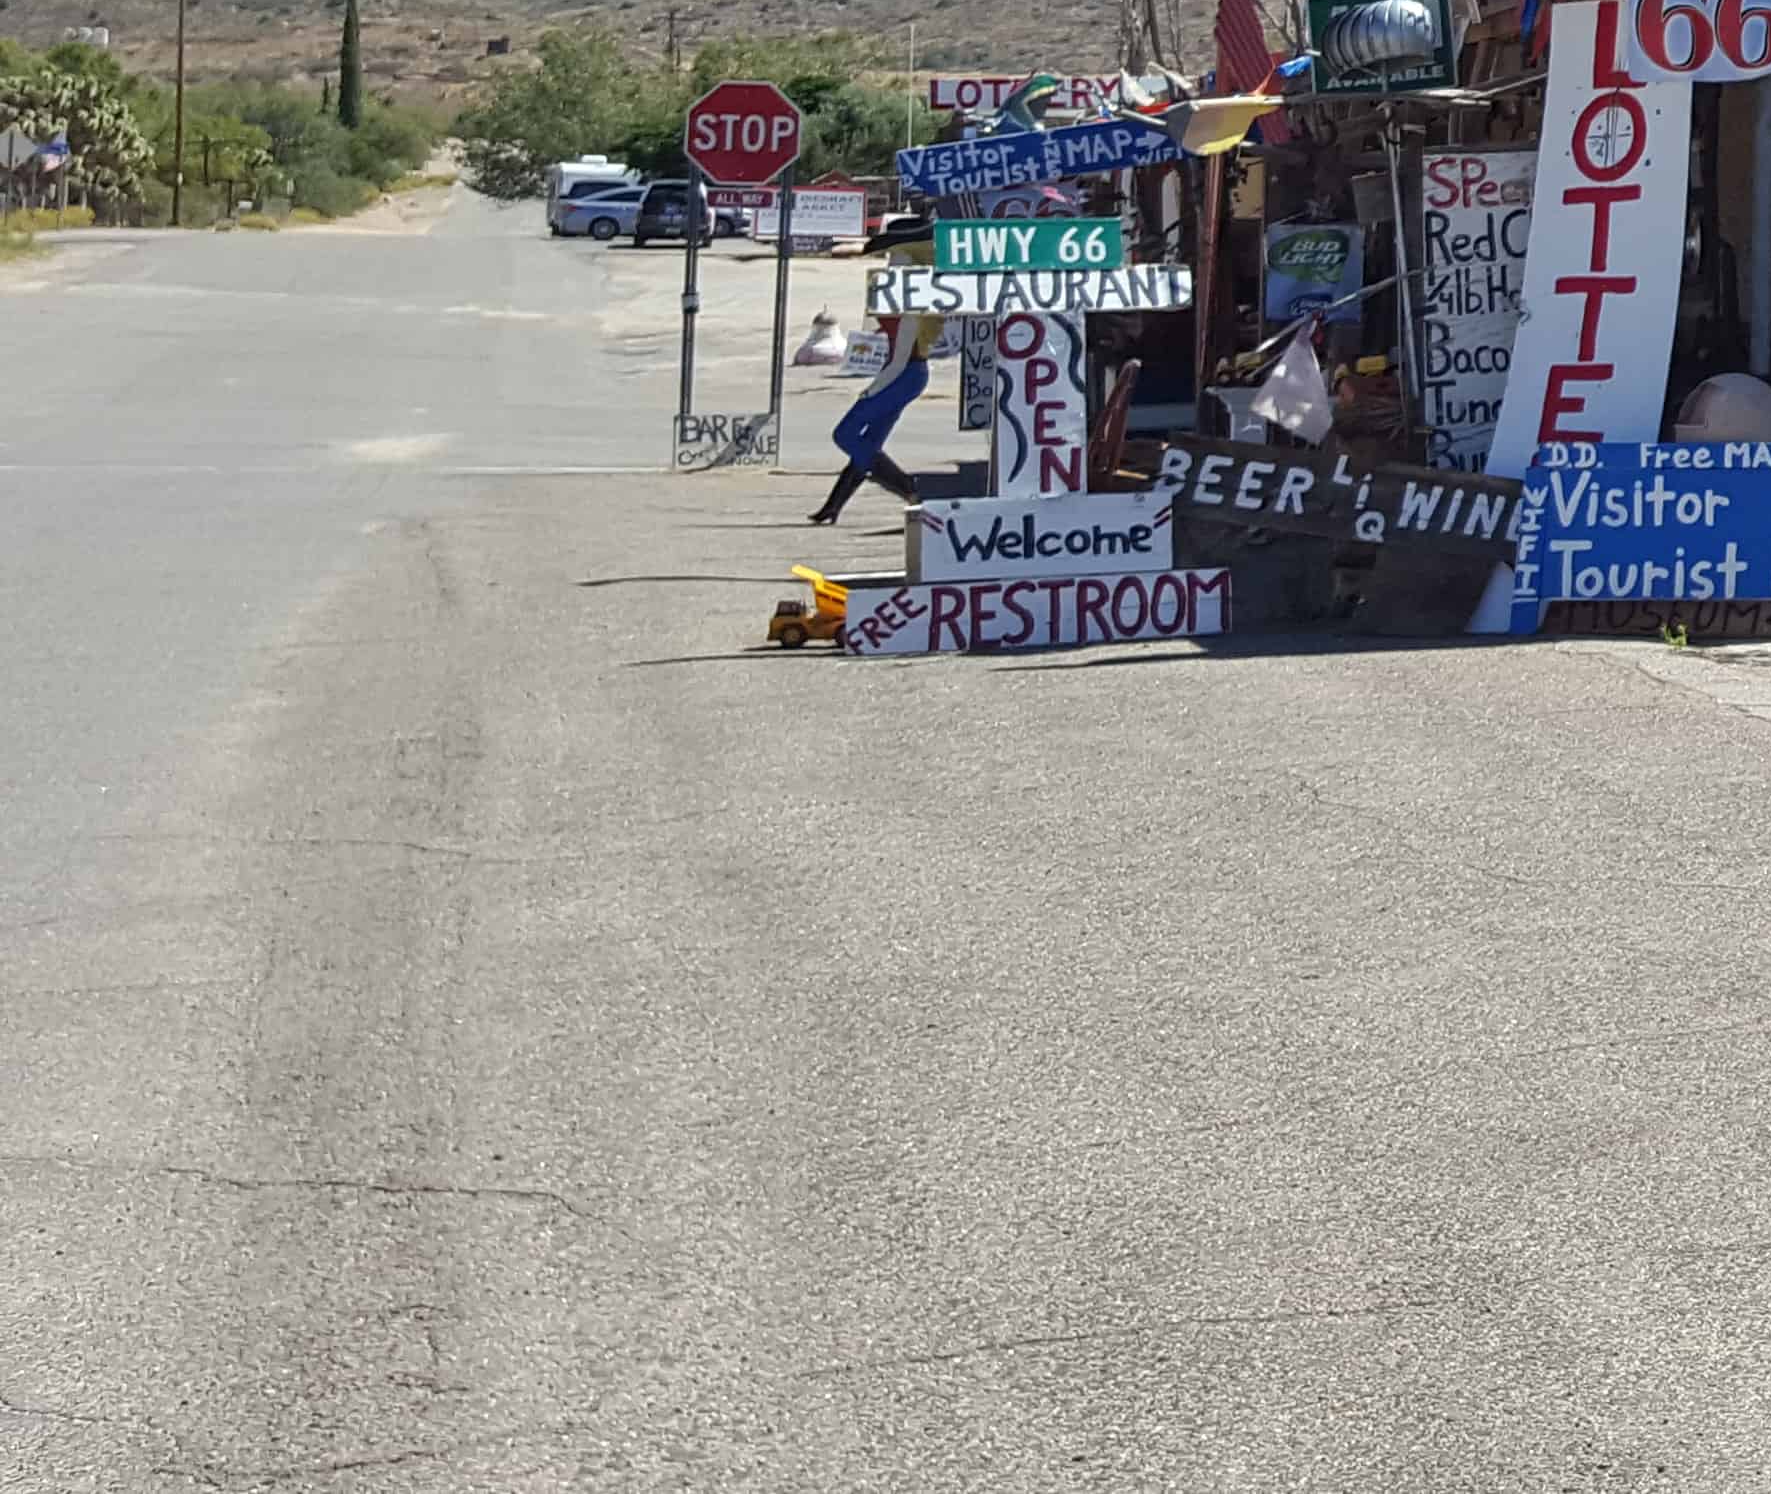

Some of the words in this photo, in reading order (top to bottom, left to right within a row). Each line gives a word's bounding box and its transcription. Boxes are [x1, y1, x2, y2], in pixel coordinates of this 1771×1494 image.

[693, 113, 797, 153] STOP
[901, 143, 1015, 176] Visitor
[1066, 130, 1134, 167] MAP
[714, 193, 736, 205] ALL
[742, 192, 765, 205] WAY
[928, 160, 1040, 197] Tourist
[949, 227, 1037, 265] HWY
[1058, 226, 1107, 263] 66
[1291, 240, 1341, 252] BUD
[1424, 210, 1497, 266] Red
[1532, 0, 1648, 466] LOTTE
[1279, 252, 1346, 265] LIGHT
[870, 266, 1189, 312] RESTAURANT
[998, 313, 1083, 492] OPEN
[1639, 442, 1713, 470] Free
[1154, 447, 1315, 515] BEER
[1550, 470, 1731, 528] Visitor
[946, 514, 1153, 563] Welcome
[1550, 539, 1748, 600] Tourist
[844, 587, 929, 655] FREE
[927, 569, 1233, 651] RESTROOM
